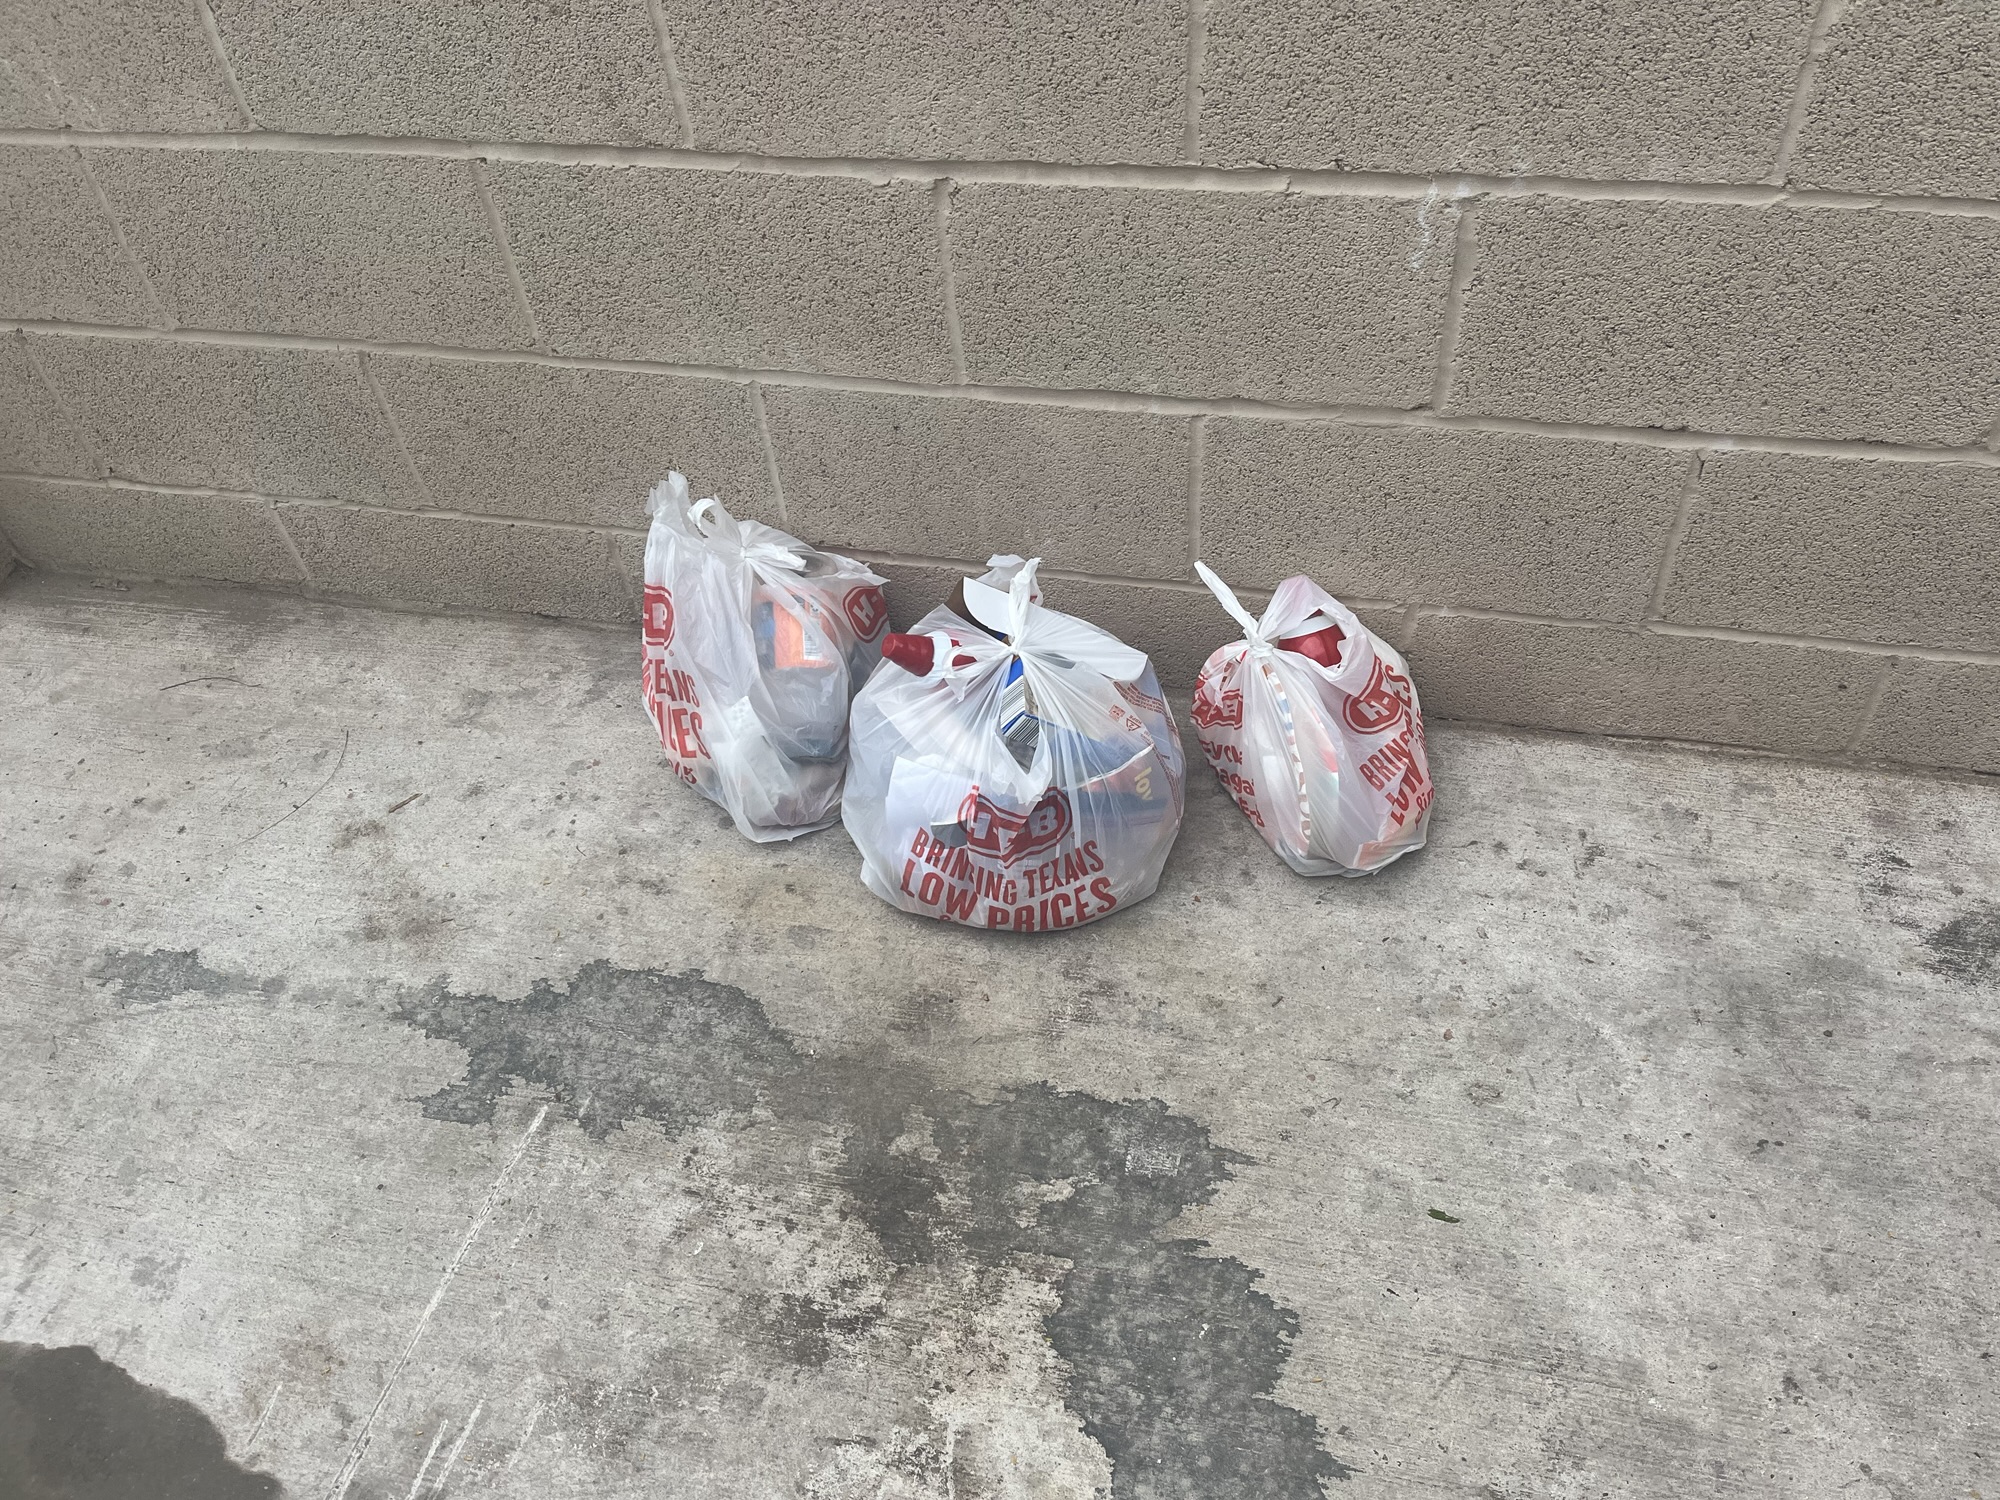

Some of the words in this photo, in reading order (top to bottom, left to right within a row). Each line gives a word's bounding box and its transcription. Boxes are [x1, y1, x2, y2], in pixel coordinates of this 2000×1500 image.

[900, 858, 978, 921] LOW
[987, 877, 1117, 931] PRICES
[1023, 840, 1104, 898] TEXANS
